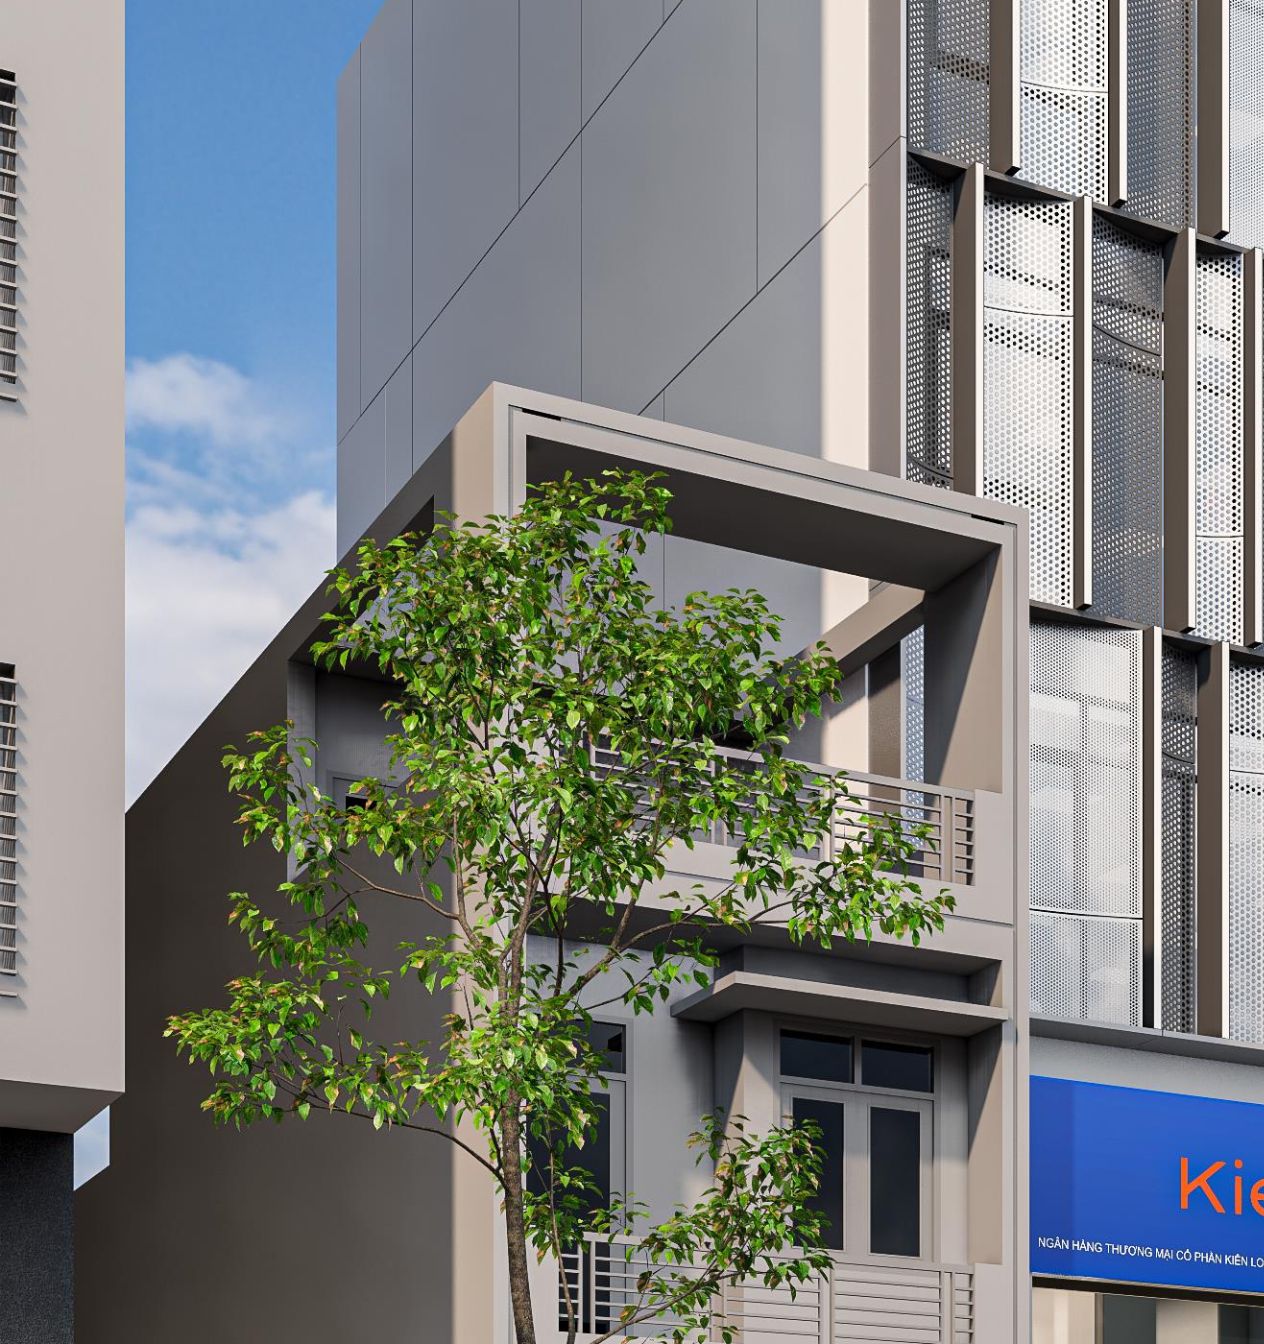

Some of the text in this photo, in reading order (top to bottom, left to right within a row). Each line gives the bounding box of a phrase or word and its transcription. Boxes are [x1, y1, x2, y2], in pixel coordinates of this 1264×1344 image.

[1038, 1236, 1069, 1250] NGÂN
[1105, 1243, 1153, 1258] THƯƠNG
[1155, 1248, 1173, 1261] MẠI
